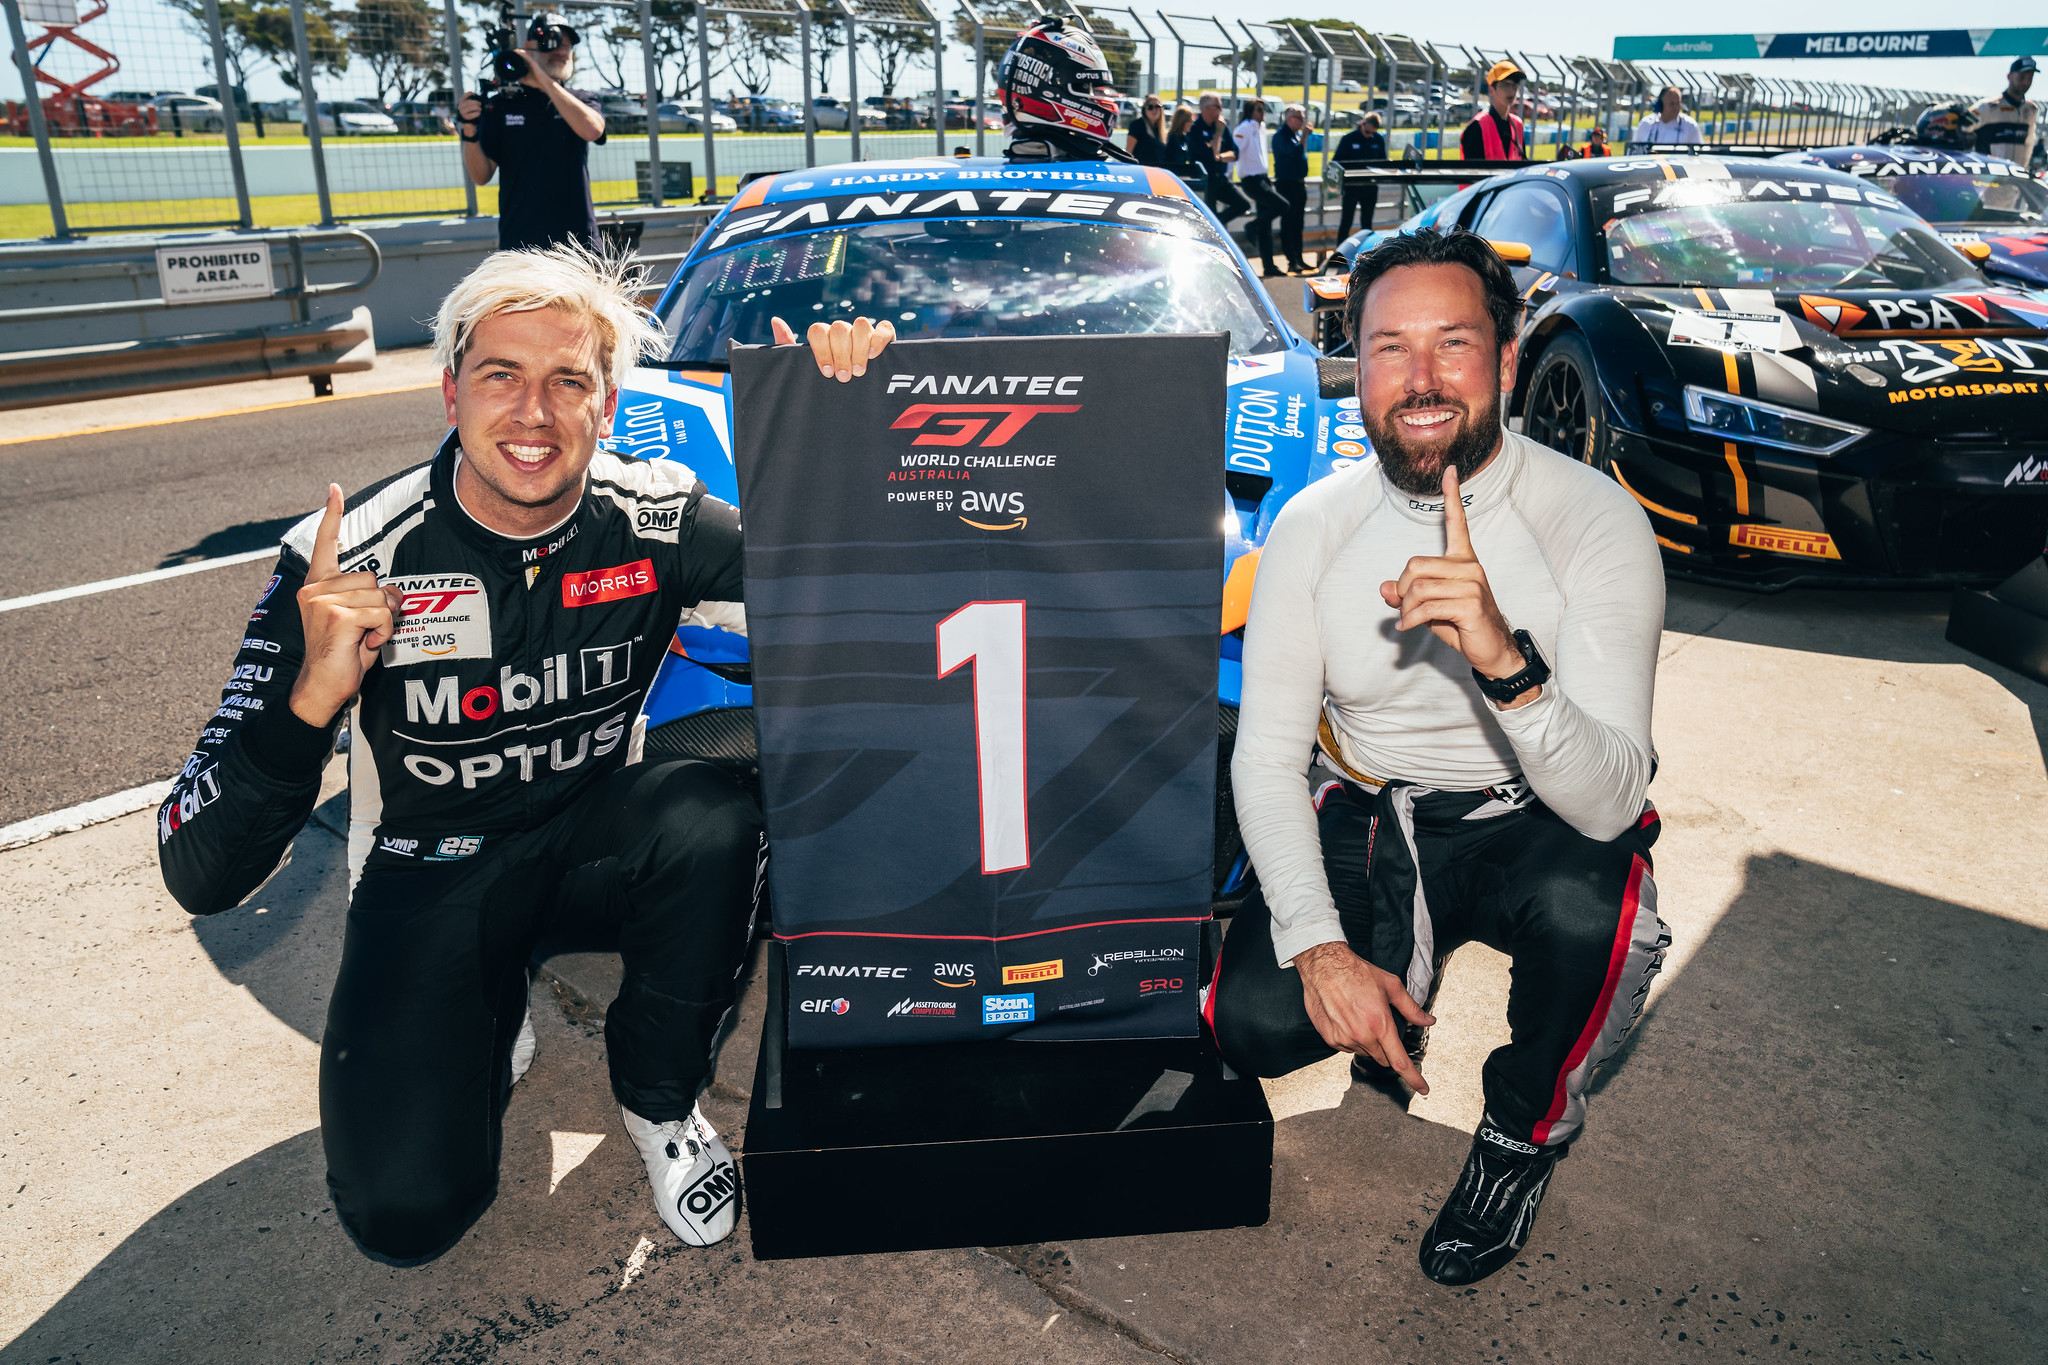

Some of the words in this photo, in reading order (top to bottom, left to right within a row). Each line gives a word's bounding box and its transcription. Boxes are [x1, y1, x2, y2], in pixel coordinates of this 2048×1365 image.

[1805, 35, 1929, 53] MELBOURNE
[1075, 72, 1100, 80] OPTUS
[830, 171, 946, 187] HARDY
[957, 170, 1135, 184] BROTHERS
[1850, 161, 2030, 179] FANATEC
[708, 191, 1181, 251] FANATEC
[167, 252, 260, 269] PROHIBITED
[196, 269, 239, 282] AREA
[1868, 299, 1962, 330] PSA
[1837, 350, 1888, 364] THE
[886, 374, 1084, 395] FANATEC
[1888, 383, 2038, 404] MOTORSPORT
[1267, 394, 1307, 438] Garage
[624, 401, 671, 460] DUTTO
[888, 403, 1084, 448] GT
[1229, 387, 1280, 472] DUTTON
[900, 454, 960, 467] WORLD
[963, 454, 1057, 468] CHALLENGE
[887, 469, 970, 482] AUSTRALIA
[887, 490, 954, 502] POWERED
[960, 490, 1025, 514] aws
[936, 501, 953, 511] BY
[637, 511, 679, 528] OMP
[1737, 525, 1830, 555] PIRELLI
[522, 537, 566, 563] Mobil
[570, 570, 649, 598] MORRIS
[393, 618, 420, 629] WORLD
[421, 614, 471, 625] CHALLENGE
[393, 625, 426, 636] USTRALIA
[386, 636, 419, 647] POWERED
[422, 633, 456, 647] aws
[404, 653, 569, 725] Mobil
[936, 599, 1031, 875] 1
[403, 711, 627, 789] OPTUS
[160, 781, 201, 845] Mobil
[202, 771, 219, 797] 1
[439, 837, 481, 856] 25
[1103, 948, 1184, 963] REBELLION
[796, 964, 907, 979] FANATEC
[933, 962, 975, 977] aws
[1007, 963, 1058, 981] PIRELLI
[1139, 978, 1184, 993] SRO
[800, 999, 832, 1013] elf
[911, 1008, 956, 1016] COMPETIZIONE
[914, 1001, 939, 1009] ASSETTO
[938, 1001, 956, 1009] CORSA
[984, 997, 1034, 1012] Stan.
[987, 1012, 1028, 1021] SPORT
[1480, 1127, 1539, 1155] alpinestars
[686, 1167, 735, 1215] OMP
